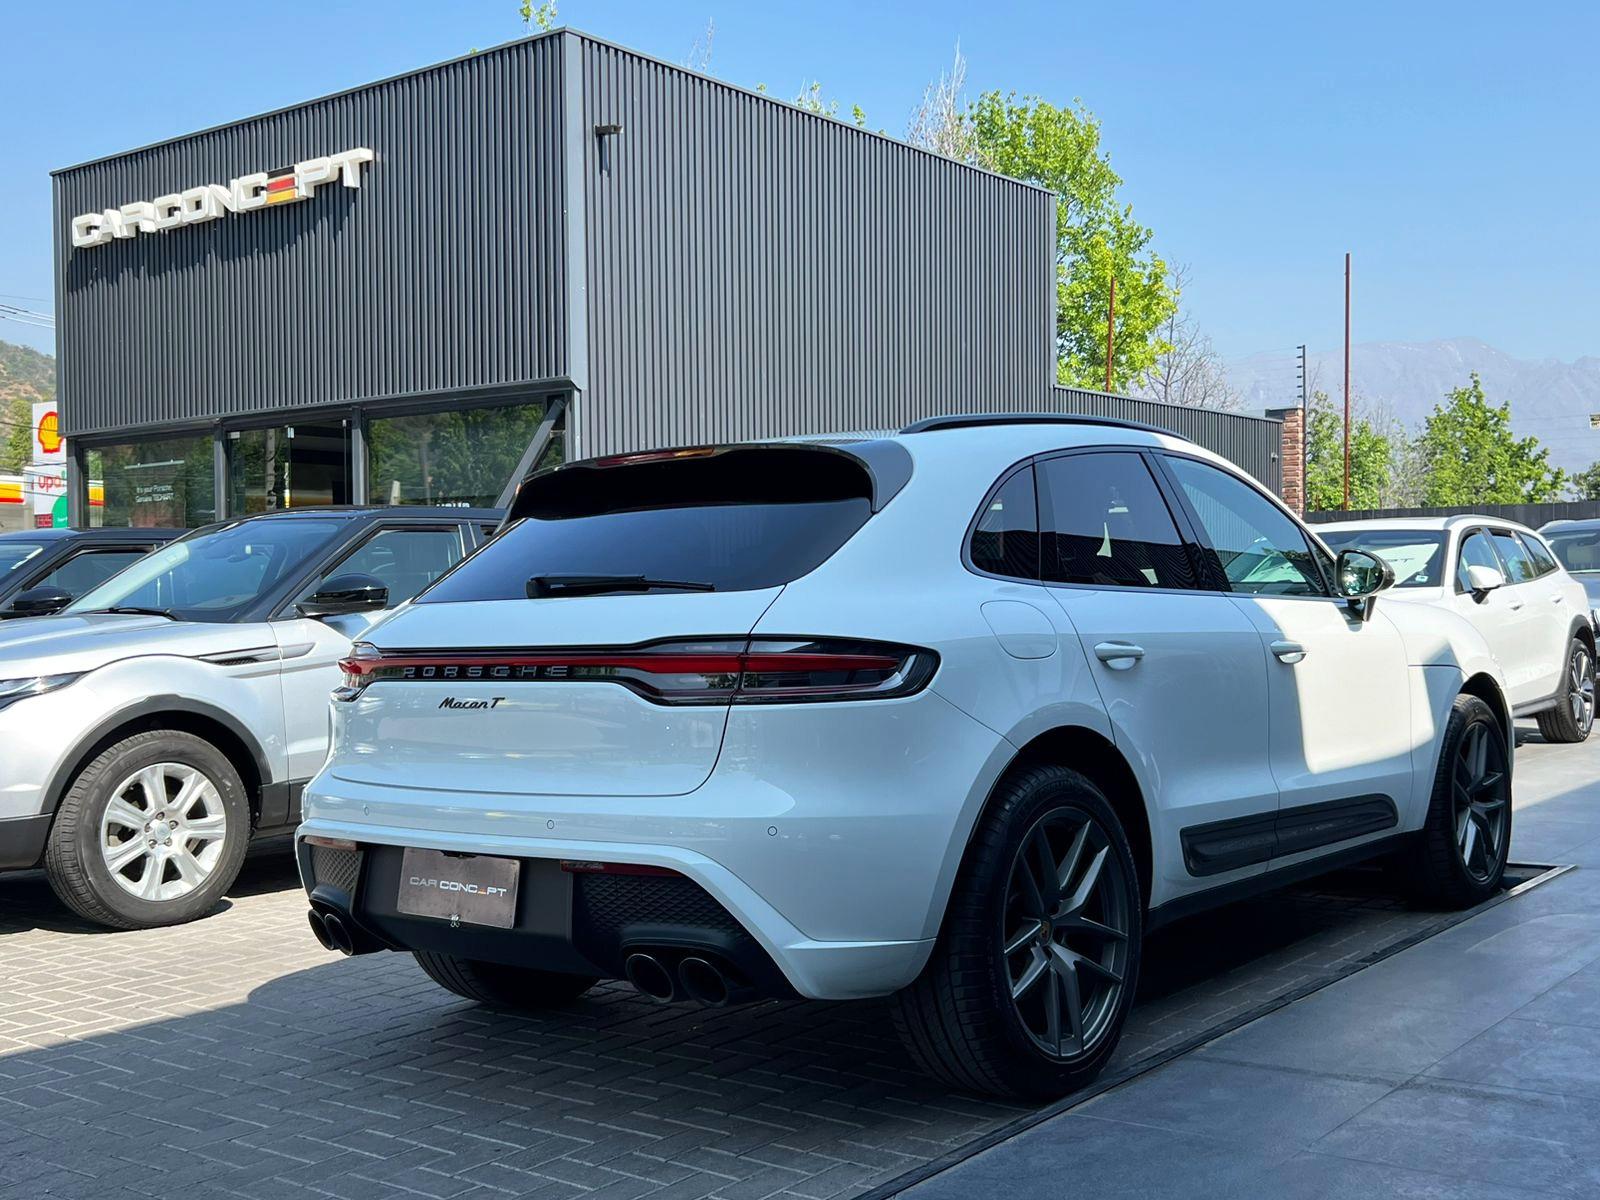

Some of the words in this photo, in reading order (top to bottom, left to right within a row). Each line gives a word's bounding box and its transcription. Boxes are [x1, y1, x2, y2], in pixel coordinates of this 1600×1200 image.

[403, 665, 568, 678] PORSCHE
[438, 696, 488, 710] Macan
[490, 696, 506, 709] T
[409, 876, 438, 888] CAR
